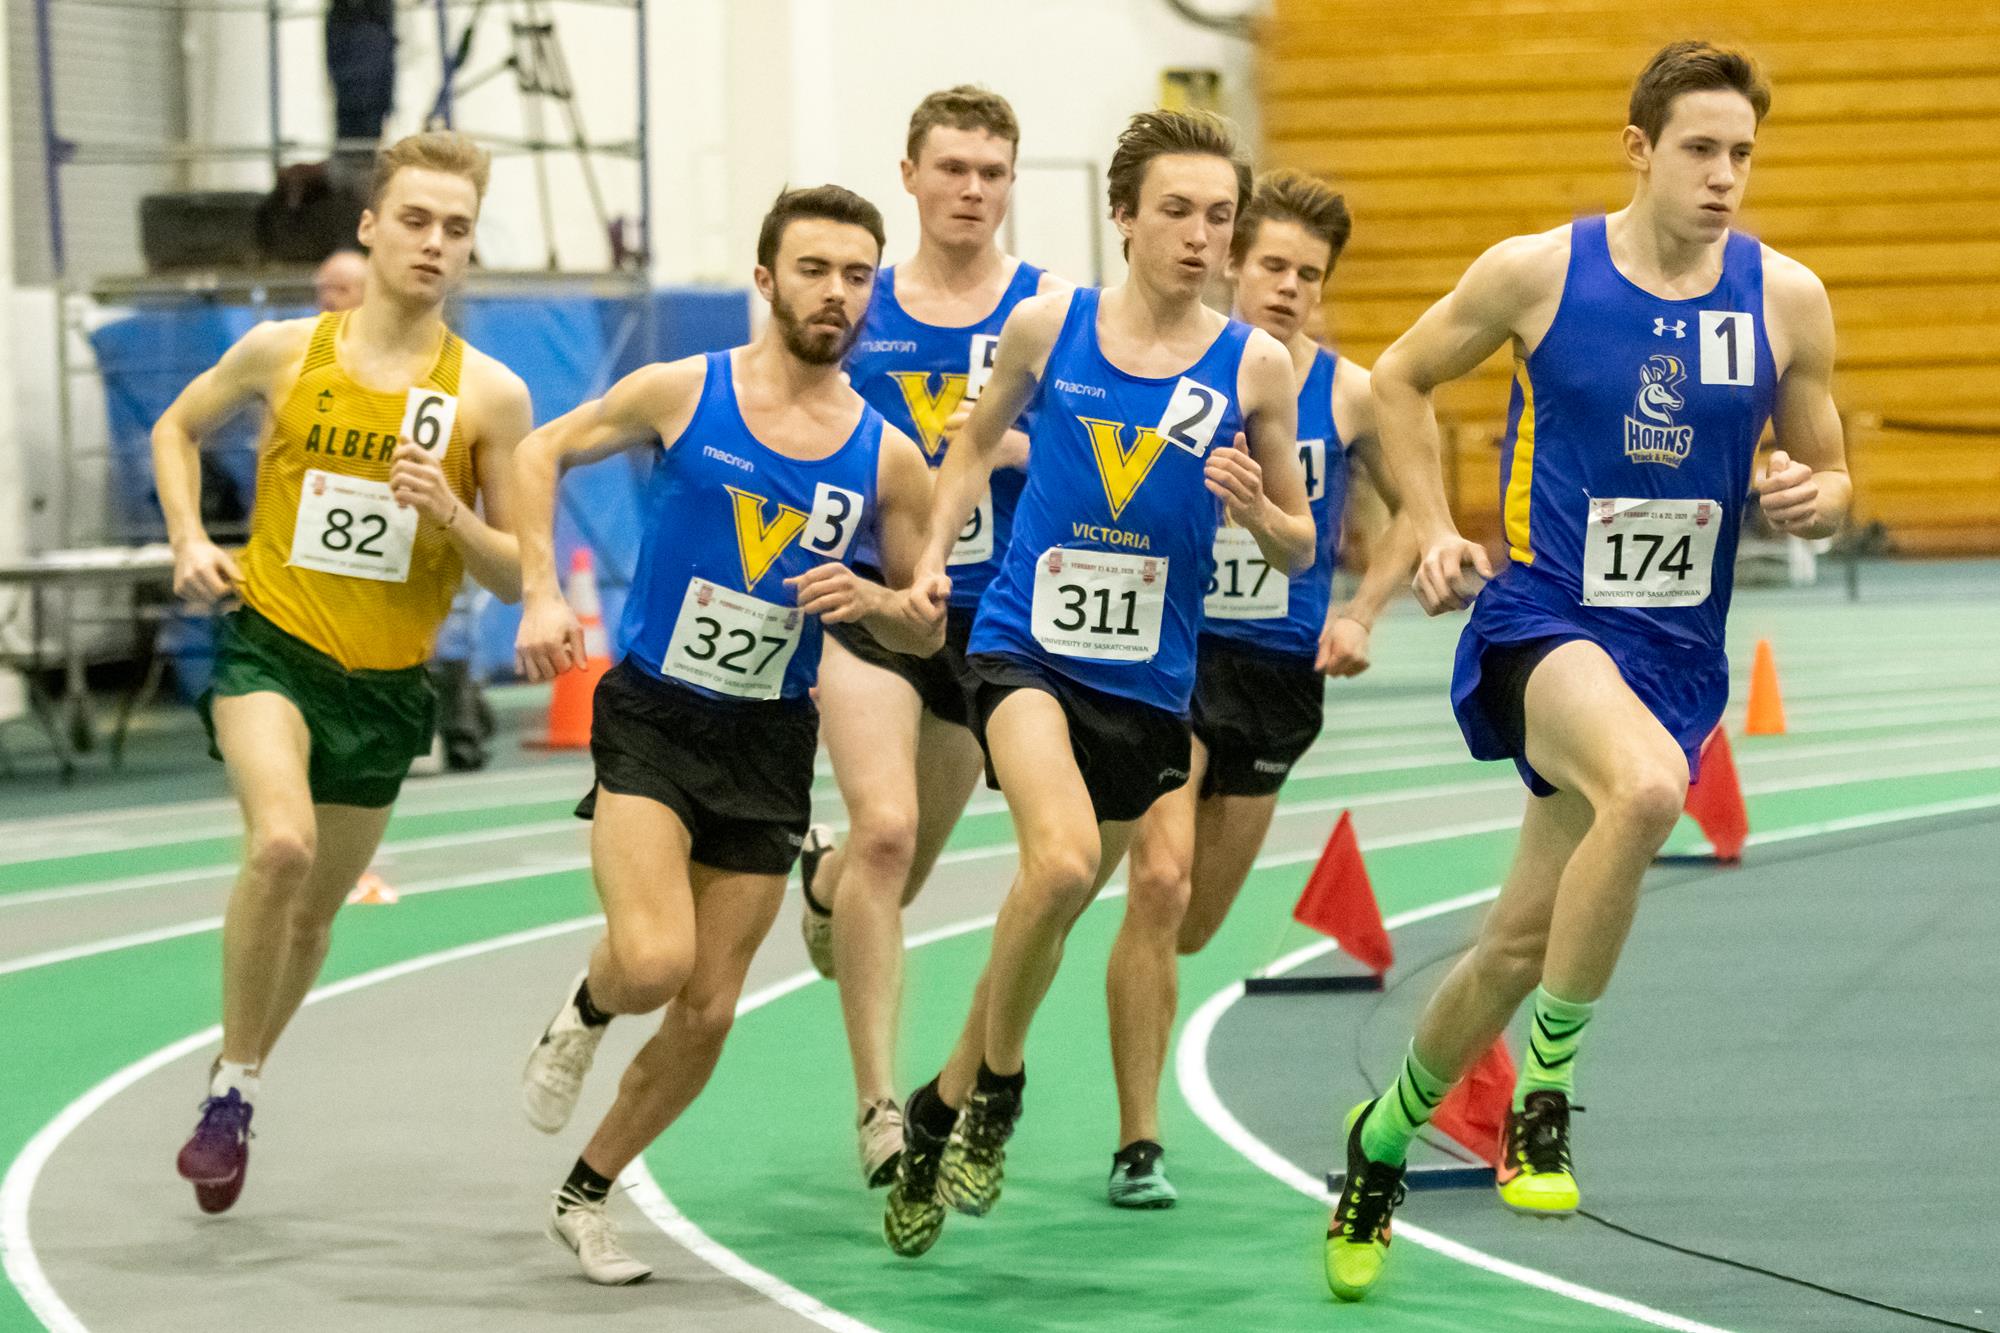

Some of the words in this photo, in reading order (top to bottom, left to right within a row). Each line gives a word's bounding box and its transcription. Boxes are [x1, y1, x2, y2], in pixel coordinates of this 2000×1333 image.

[1714, 316, 1738, 381] 1
[1054, 379, 1106, 399] macron
[412, 396, 444, 451] 6
[1168, 387, 1214, 450] 2
[1628, 420, 1691, 456] HORNS
[703, 445, 754, 472] macron
[321, 508, 388, 557] 82
[811, 490, 851, 552] 3
[1072, 522, 1151, 550] VICTORIA
[1604, 533, 1693, 581] 174
[1053, 584, 1139, 636] 311
[1594, 590, 1634, 598] UNIVERSITY
[1635, 590, 1645, 598] OF
[683, 616, 788, 676] 327
[1041, 636, 1081, 649] UNIVERSITY
[1082, 641, 1092, 649] OF
